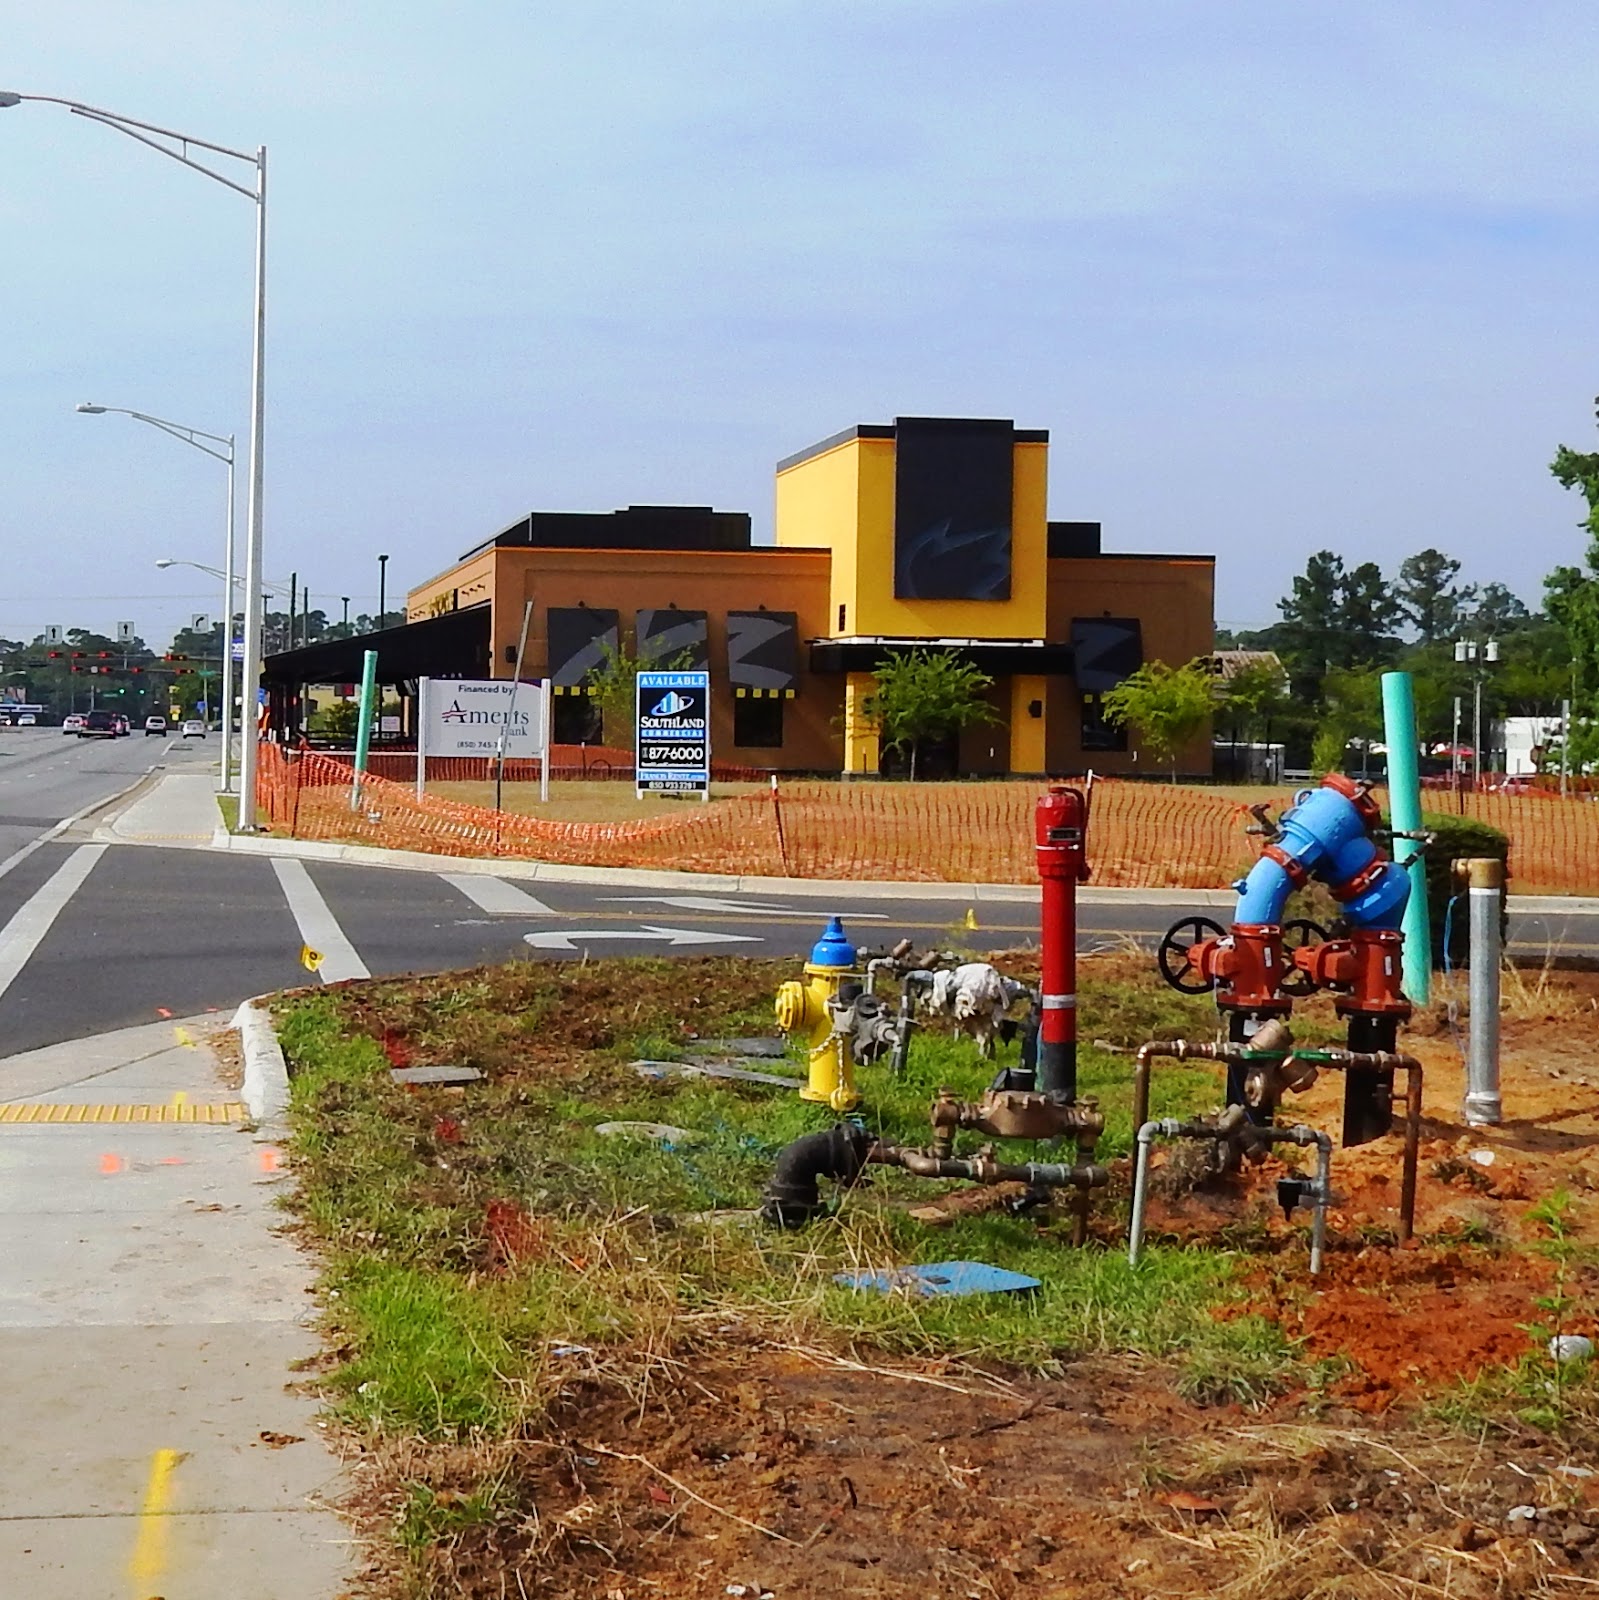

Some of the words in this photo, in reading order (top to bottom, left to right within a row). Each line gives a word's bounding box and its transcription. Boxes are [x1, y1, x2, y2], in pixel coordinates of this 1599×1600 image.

[641, 676, 705, 686] AVAILABLE
[458, 684, 499, 693] Financed
[502, 686, 514, 696] by
[648, 747, 704, 760] 877-6000
